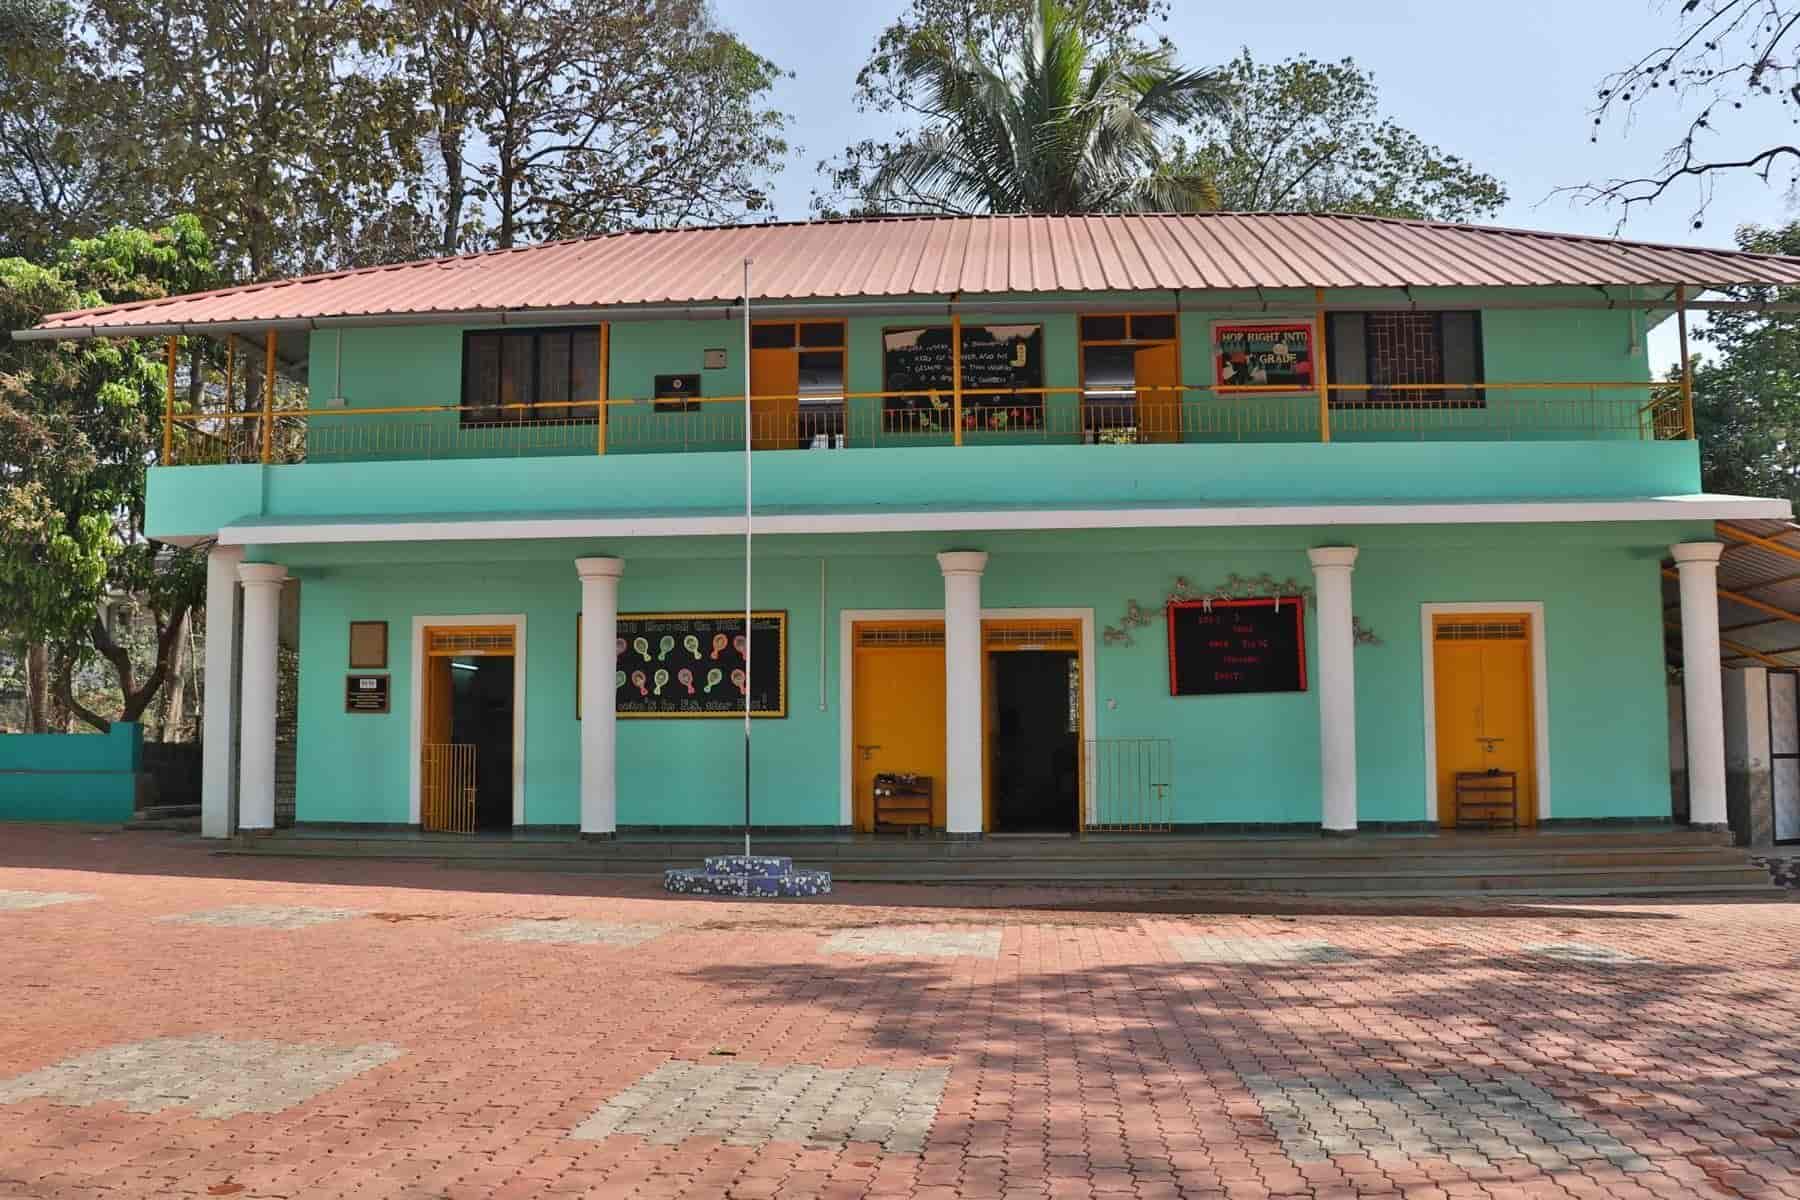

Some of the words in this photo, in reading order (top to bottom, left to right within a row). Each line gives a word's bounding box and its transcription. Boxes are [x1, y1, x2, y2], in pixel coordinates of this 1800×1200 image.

[1222, 332, 1244, 342] HOP
[1248, 332, 1282, 342] RIGHT
[1284, 331, 1308, 342] INTO
[1260, 353, 1296, 364] GRADE
